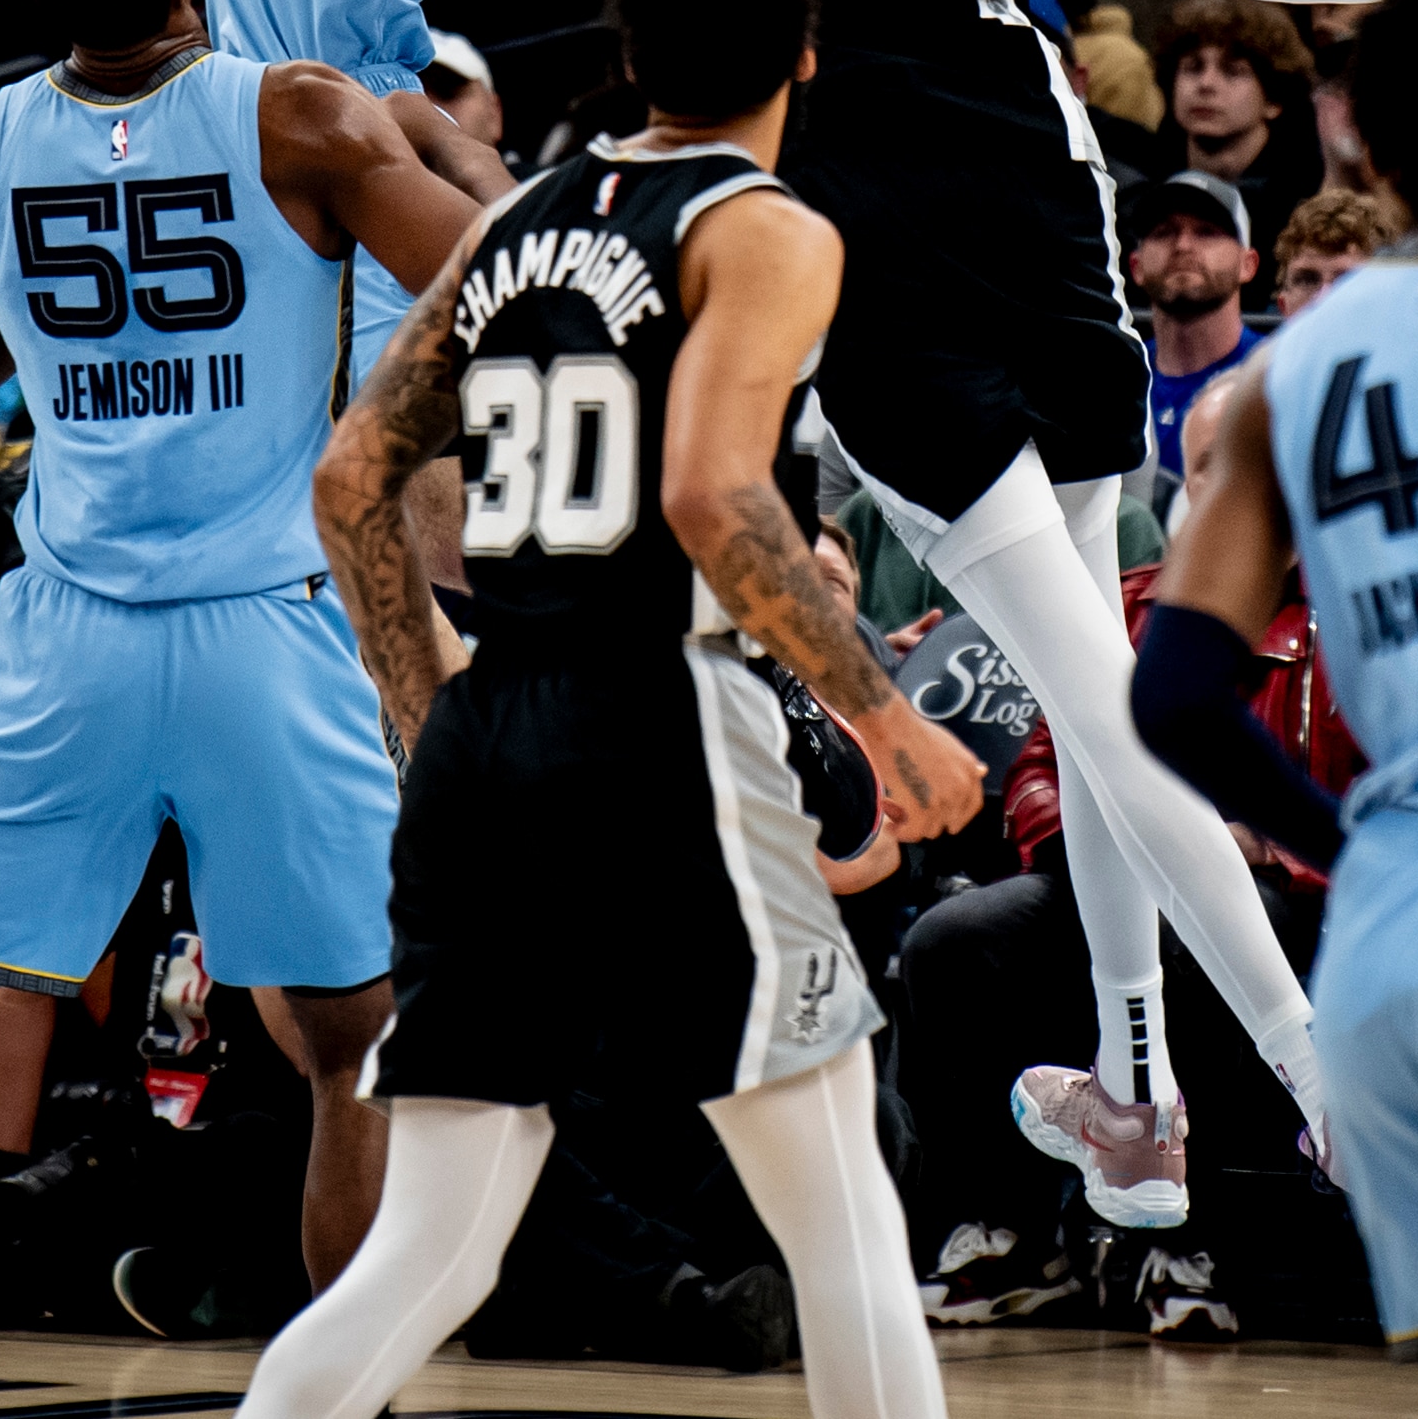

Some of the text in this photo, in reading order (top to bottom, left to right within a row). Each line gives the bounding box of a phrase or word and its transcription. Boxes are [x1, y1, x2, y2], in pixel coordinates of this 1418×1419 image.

[10, 172, 246, 339] 55
[52, 353, 245, 422] JEMISON III
[458, 354, 641, 558] 30
